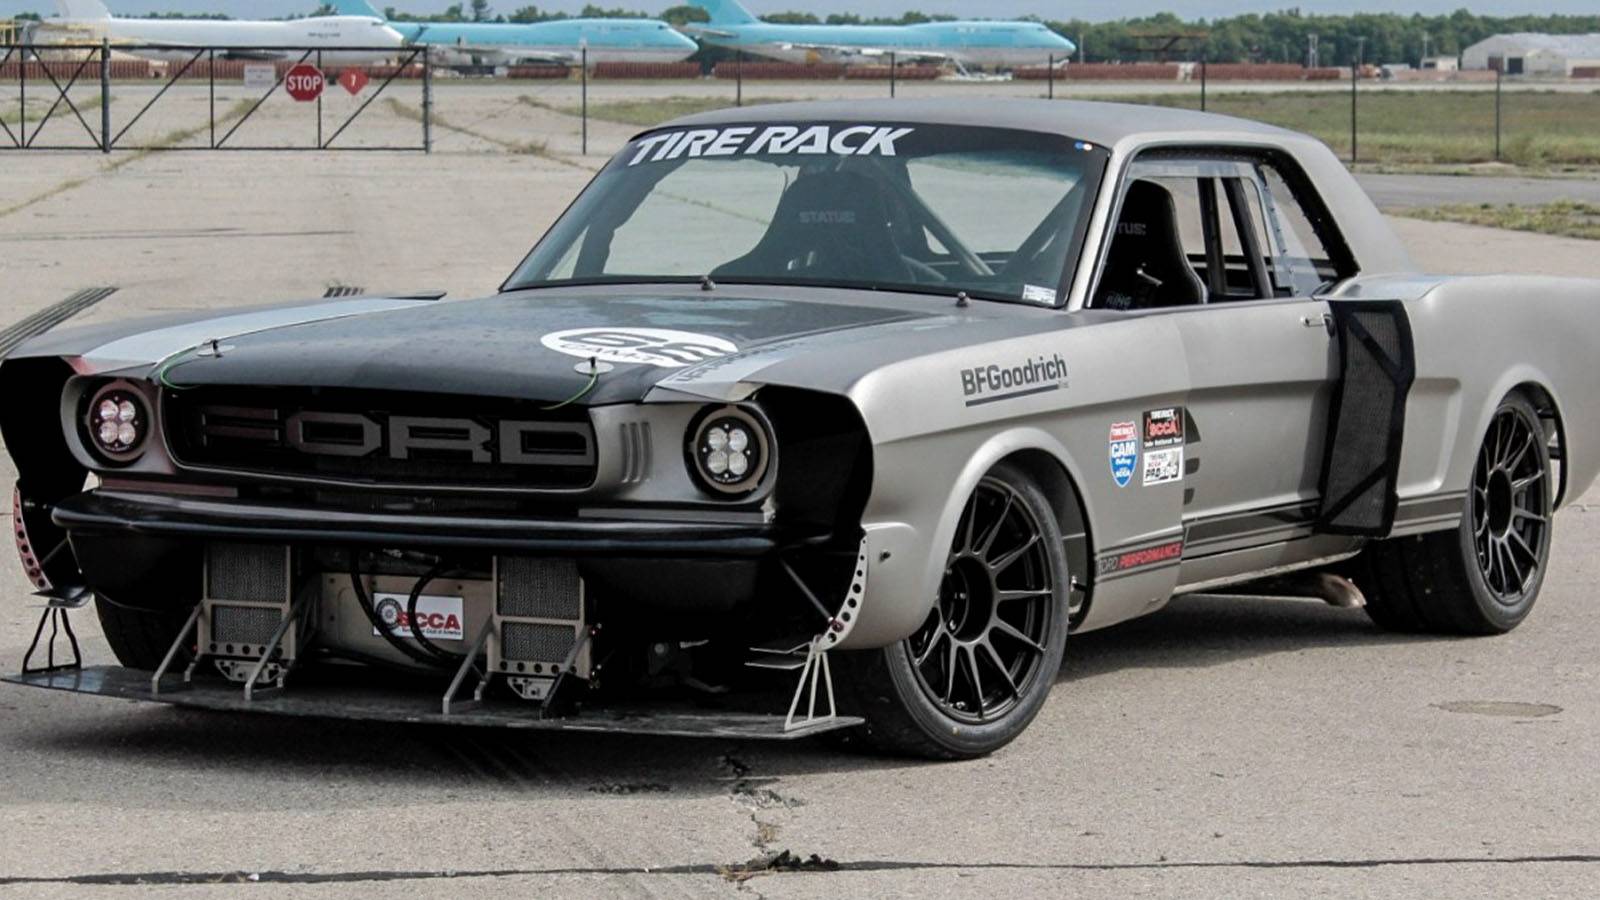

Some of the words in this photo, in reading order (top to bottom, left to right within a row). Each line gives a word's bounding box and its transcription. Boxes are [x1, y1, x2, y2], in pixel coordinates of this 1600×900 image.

[288, 75, 321, 91] STOP
[628, 127, 756, 166] TIRE
[745, 125, 915, 156] RACK
[960, 353, 1067, 396] BFGoodrich
[201, 405, 595, 466] FORD
[1111, 442, 1136, 458] CAM
[1119, 542, 1182, 568] PERFORMANCE
[397, 611, 460, 630] SCCA
